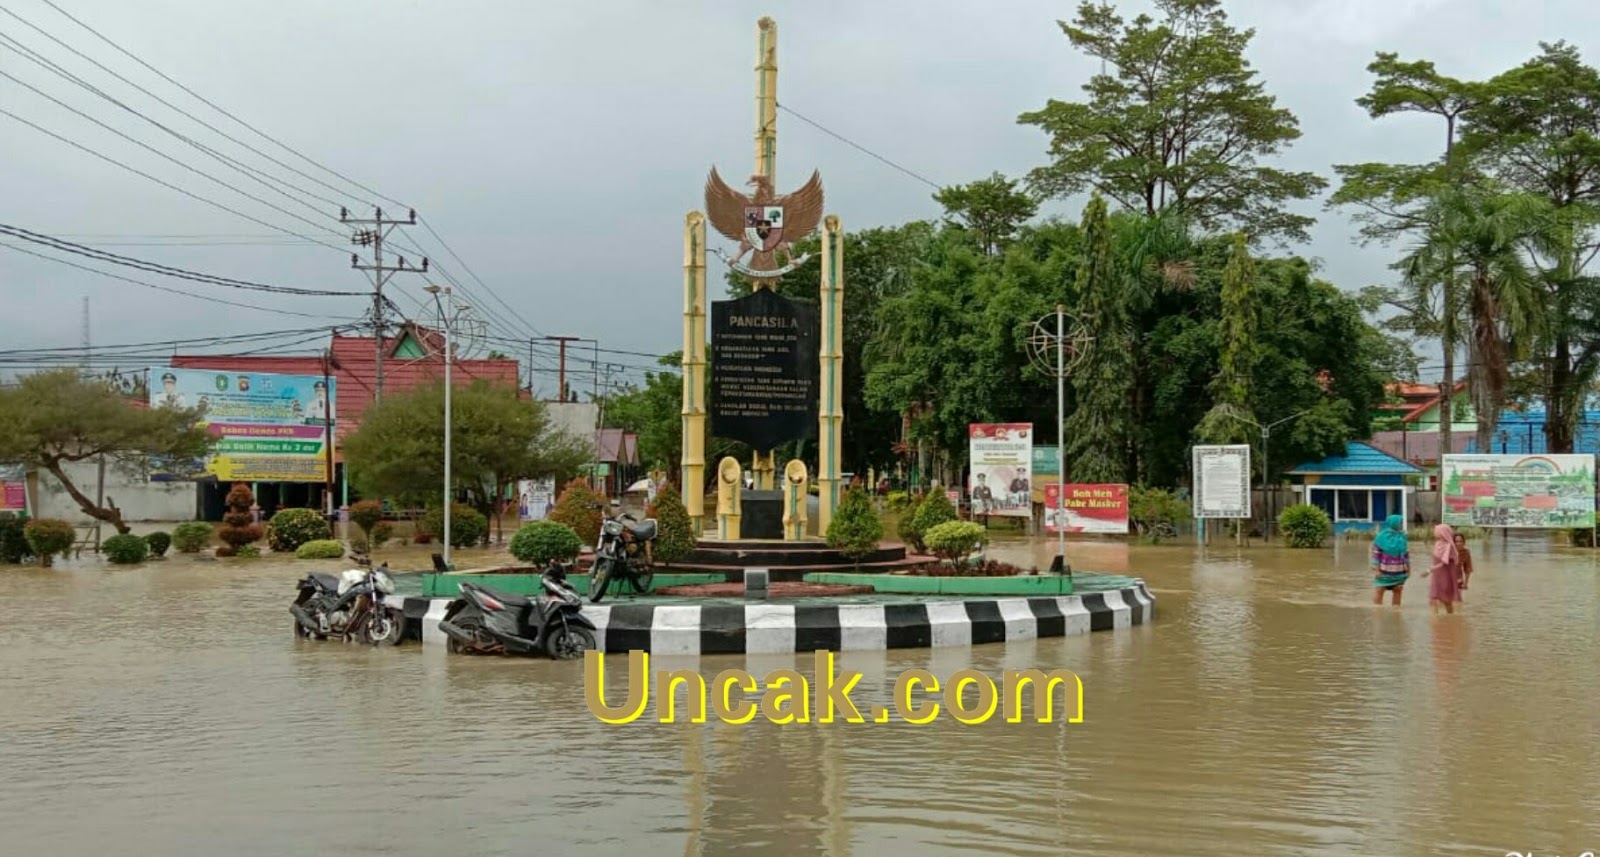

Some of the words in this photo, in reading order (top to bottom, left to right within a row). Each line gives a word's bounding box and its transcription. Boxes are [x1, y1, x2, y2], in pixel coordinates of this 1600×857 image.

[729, 315, 799, 328] PANCASILA
[1064, 499, 1086, 508] Pake
[1088, 499, 1121, 508] Masker
